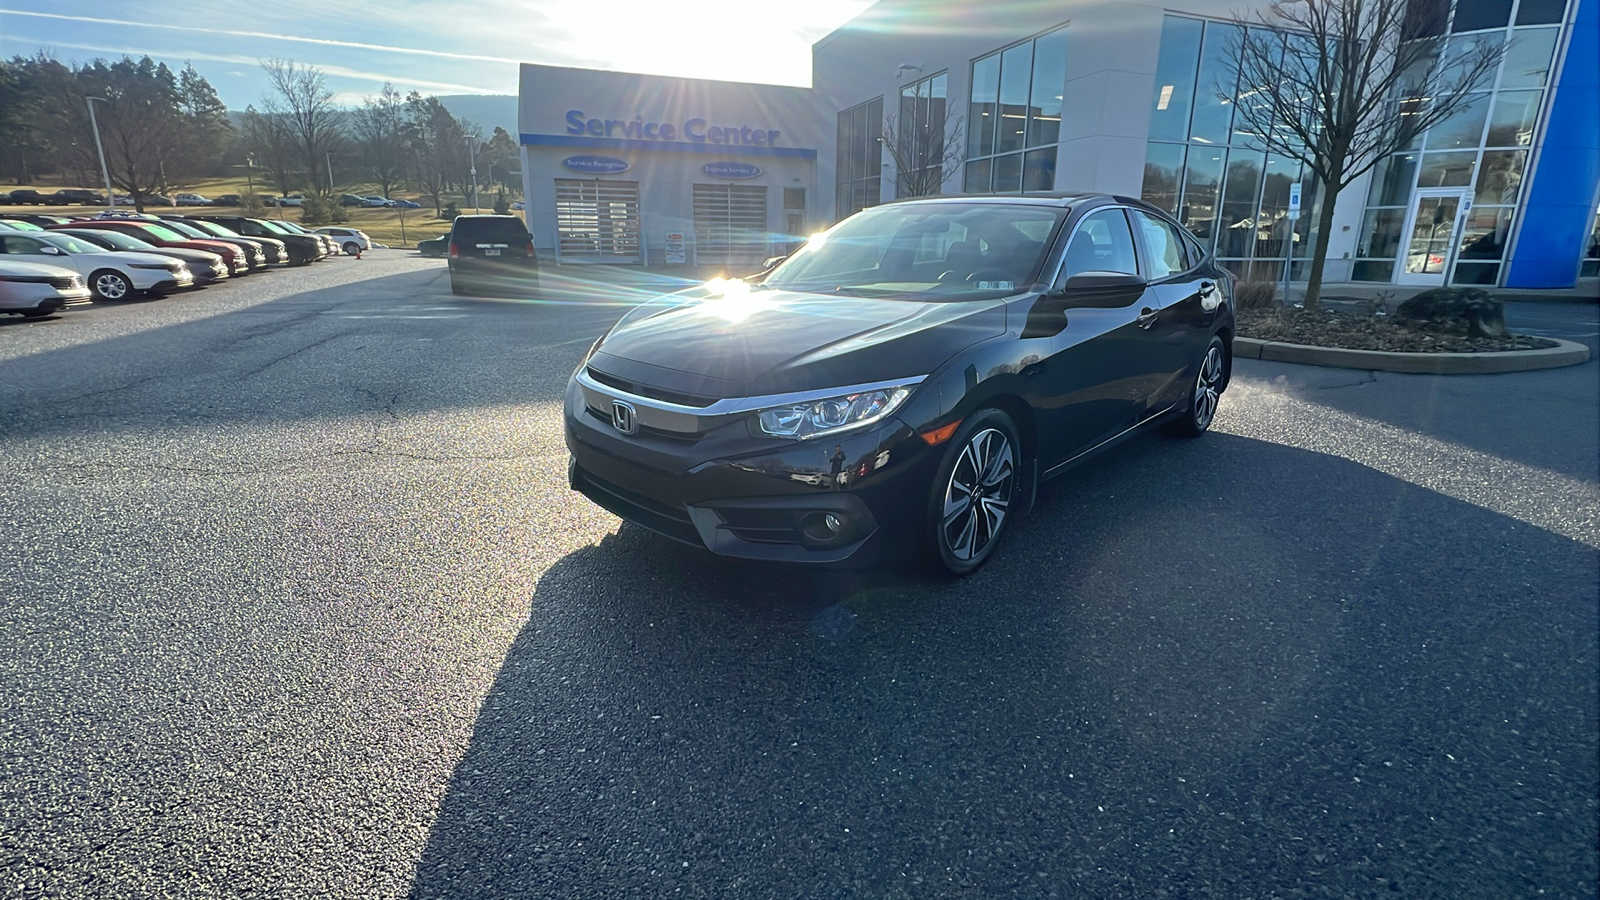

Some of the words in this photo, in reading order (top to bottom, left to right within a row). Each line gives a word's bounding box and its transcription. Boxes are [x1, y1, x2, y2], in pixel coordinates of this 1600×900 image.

[566, 109, 676, 141] Service
[684, 117, 781, 146] Center
[567, 159, 592, 167] Service
